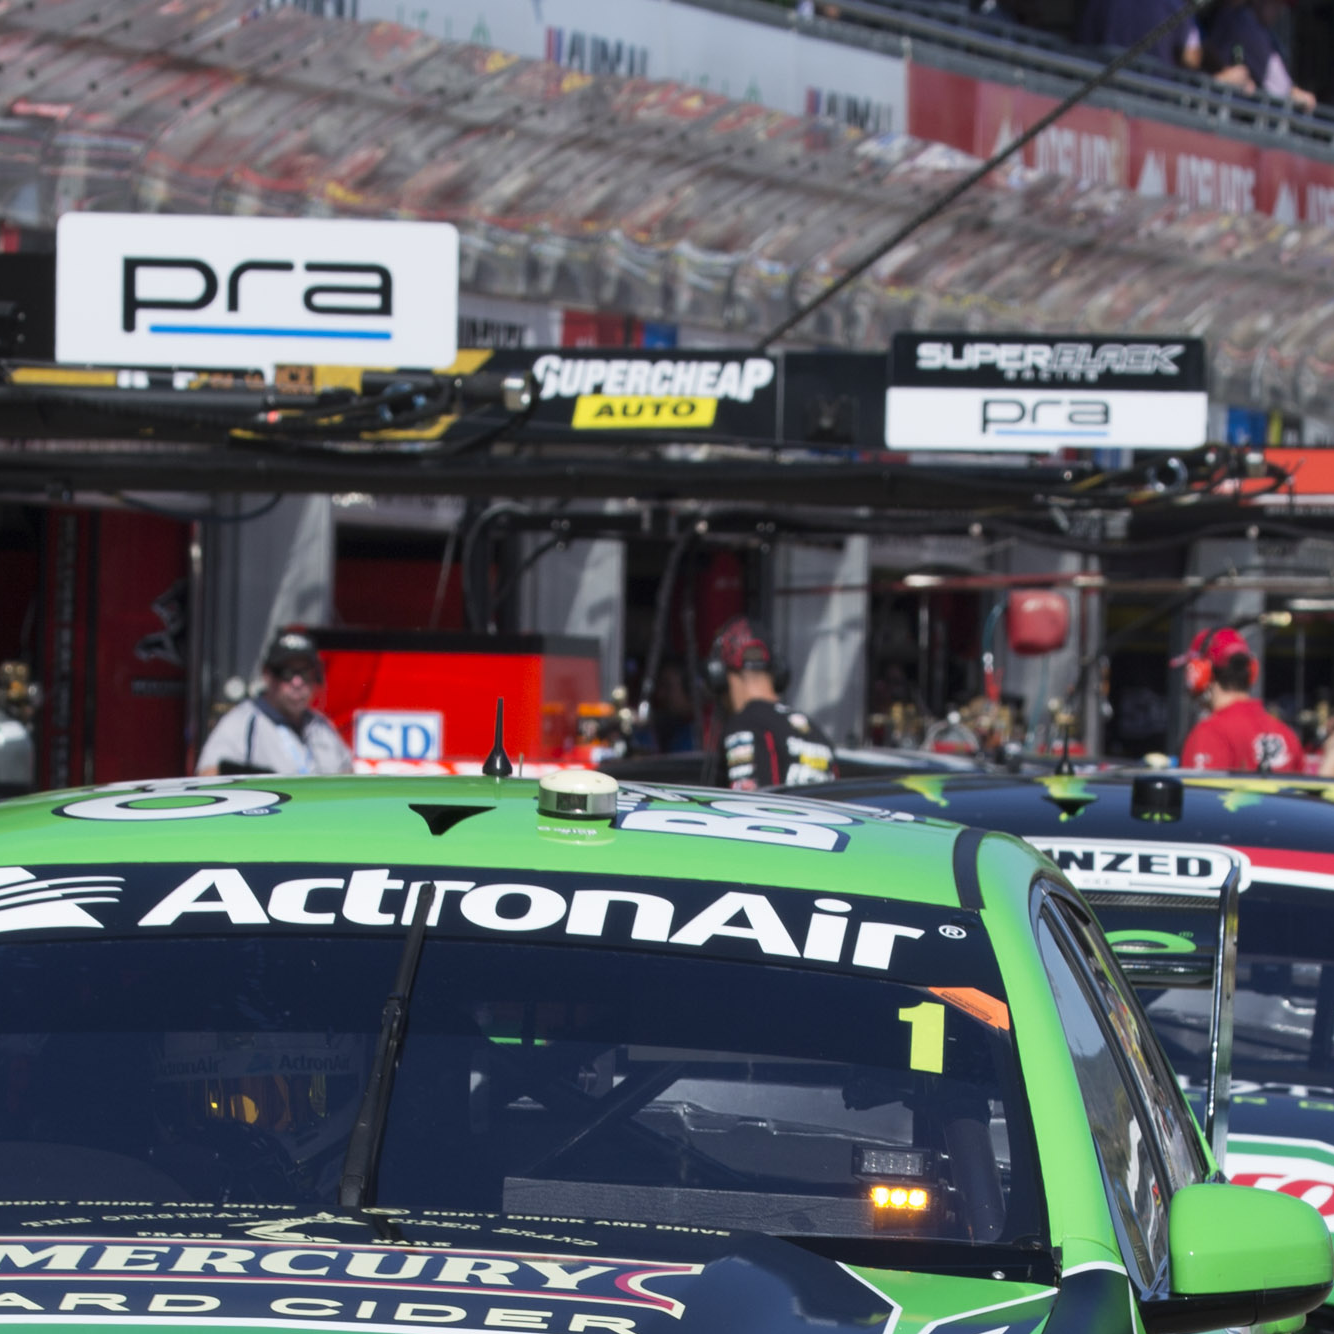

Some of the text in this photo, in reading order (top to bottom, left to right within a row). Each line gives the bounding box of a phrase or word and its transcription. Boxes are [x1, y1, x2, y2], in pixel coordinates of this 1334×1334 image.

[122, 256, 392, 332] pra
[532, 354, 775, 402] SUPERCHEAP
[595, 402, 697, 419] AUTO
[982, 399, 1110, 434] pra
[1041, 849, 1212, 878] NZED
[898, 1001, 945, 1074] 1
[101, 1212, 260, 1222] ORIGINAL
[507, 1214, 584, 1224] DRINK
[594, 1220, 648, 1229] AND
[655, 1225, 731, 1237] DRIVE
[371, 1238, 452, 1248] MARK
